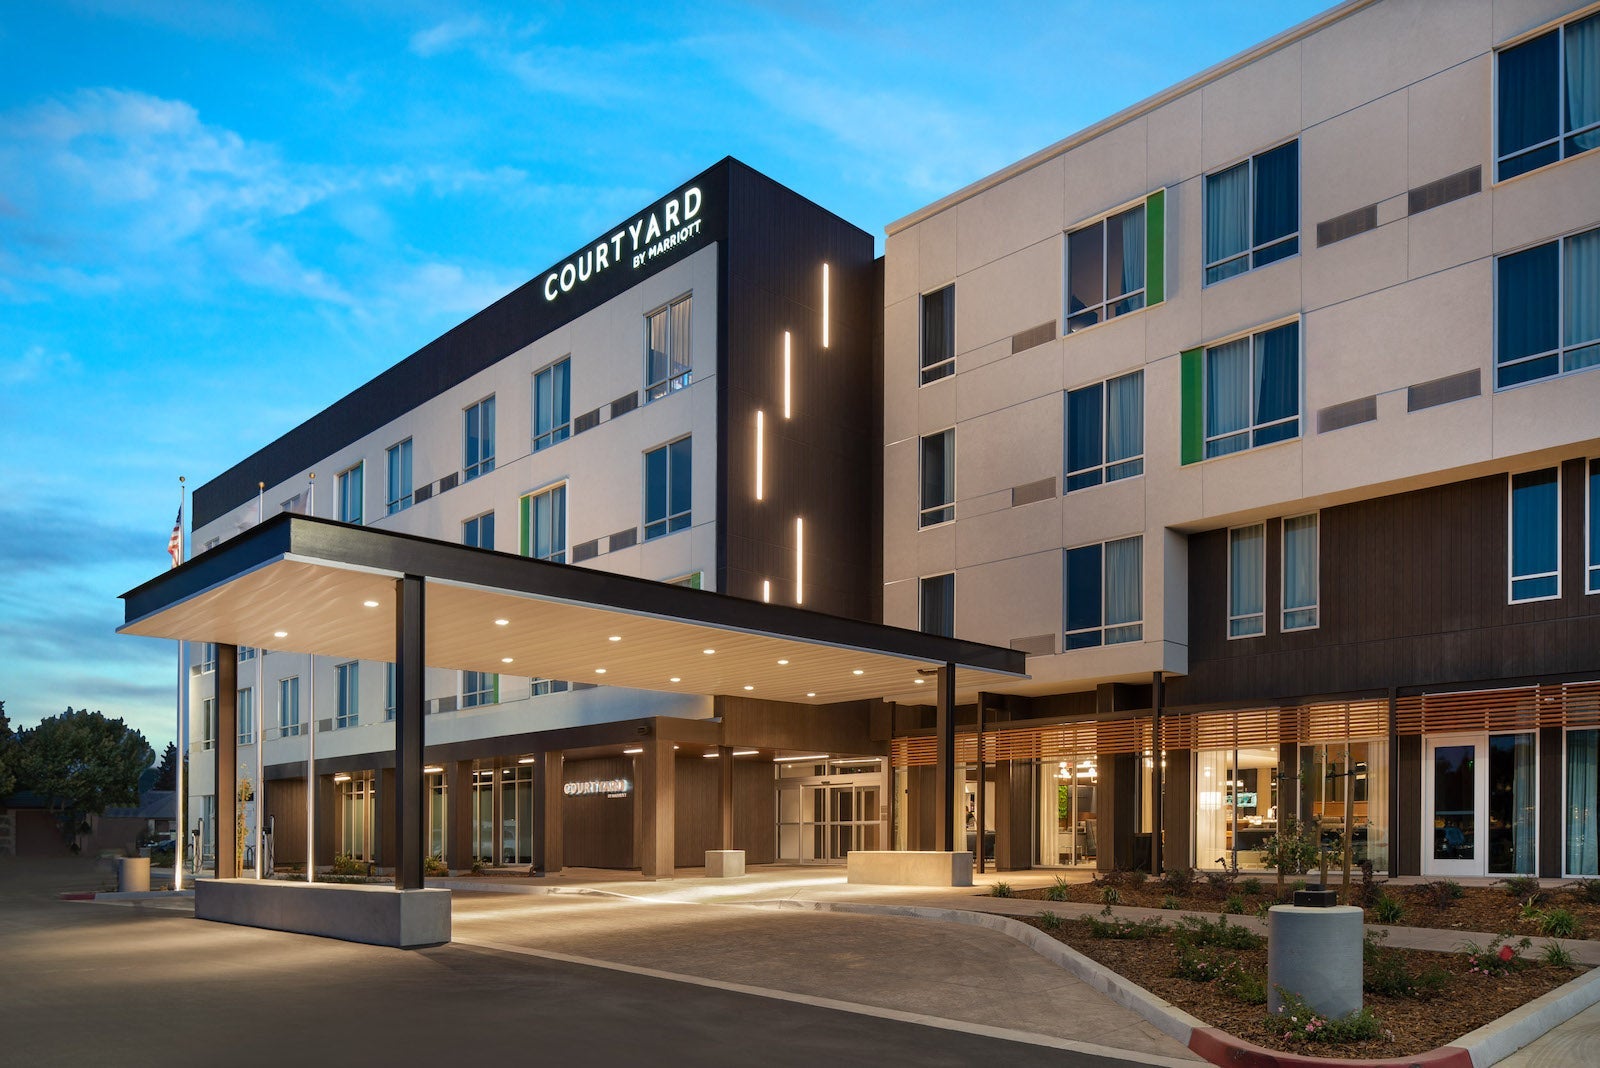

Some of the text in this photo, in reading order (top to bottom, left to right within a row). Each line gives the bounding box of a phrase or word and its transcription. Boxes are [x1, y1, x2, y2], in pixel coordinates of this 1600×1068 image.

[544, 187, 702, 301] COURTYARD
[633, 219, 702, 269] BY MARRIOTT
